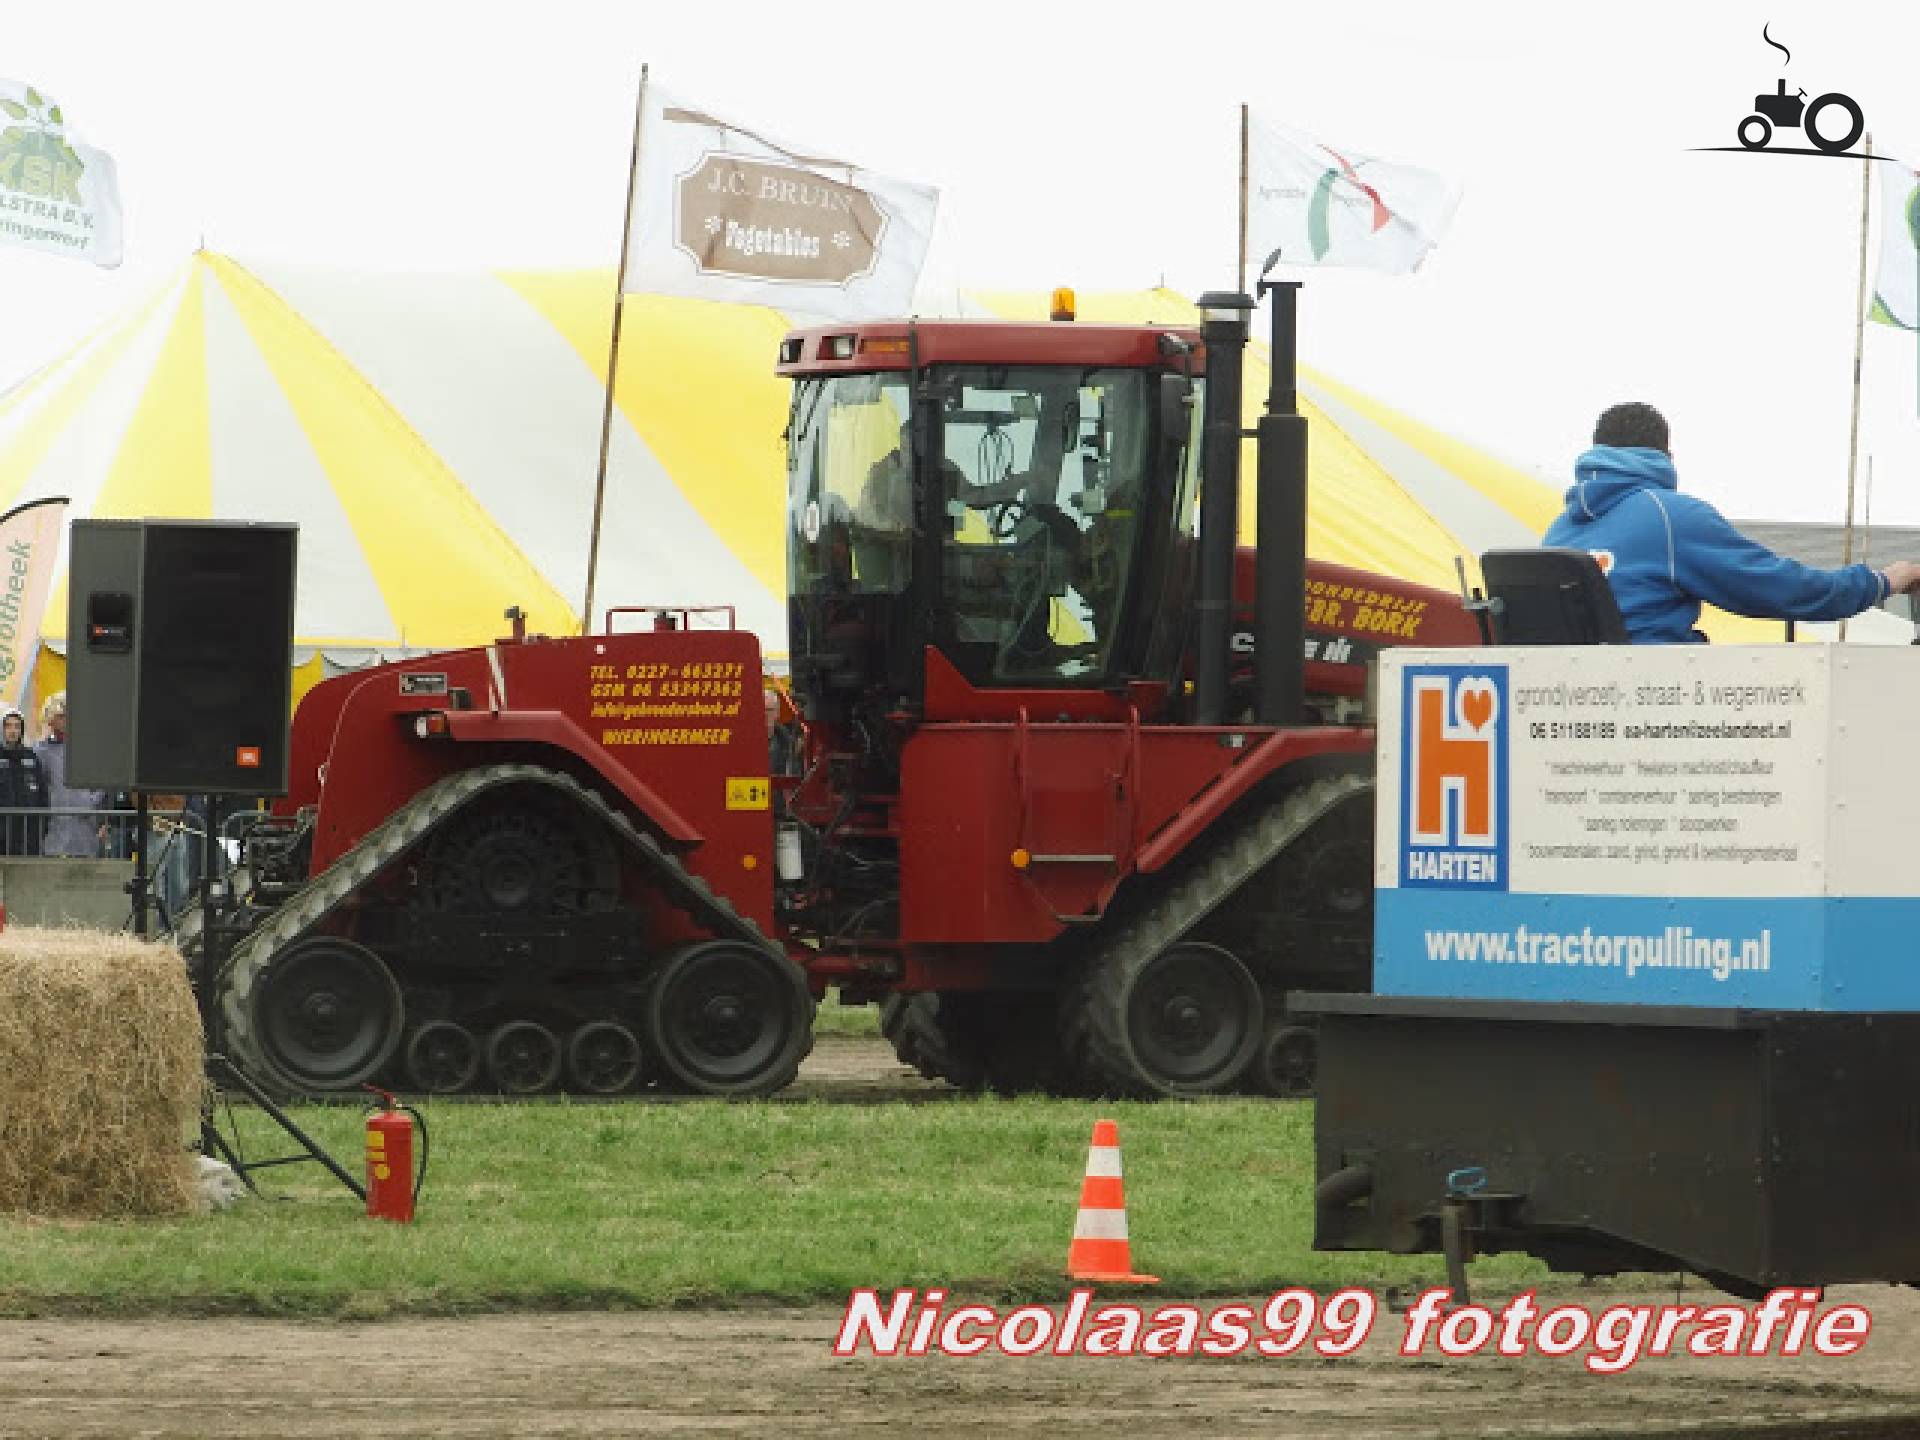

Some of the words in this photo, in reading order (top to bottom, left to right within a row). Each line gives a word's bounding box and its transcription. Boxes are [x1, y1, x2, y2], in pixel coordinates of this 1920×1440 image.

[1353, 606, 1421, 638] BORK
[591, 665, 619, 679] TEL.
[591, 683, 625, 697] GSM
[1694, 680, 1705, 706] &
[1709, 680, 1807, 711] wegenwerk
[1410, 852, 1498, 882] HARTEN
[1424, 924, 1771, 980] www.tractorpulling.nl
